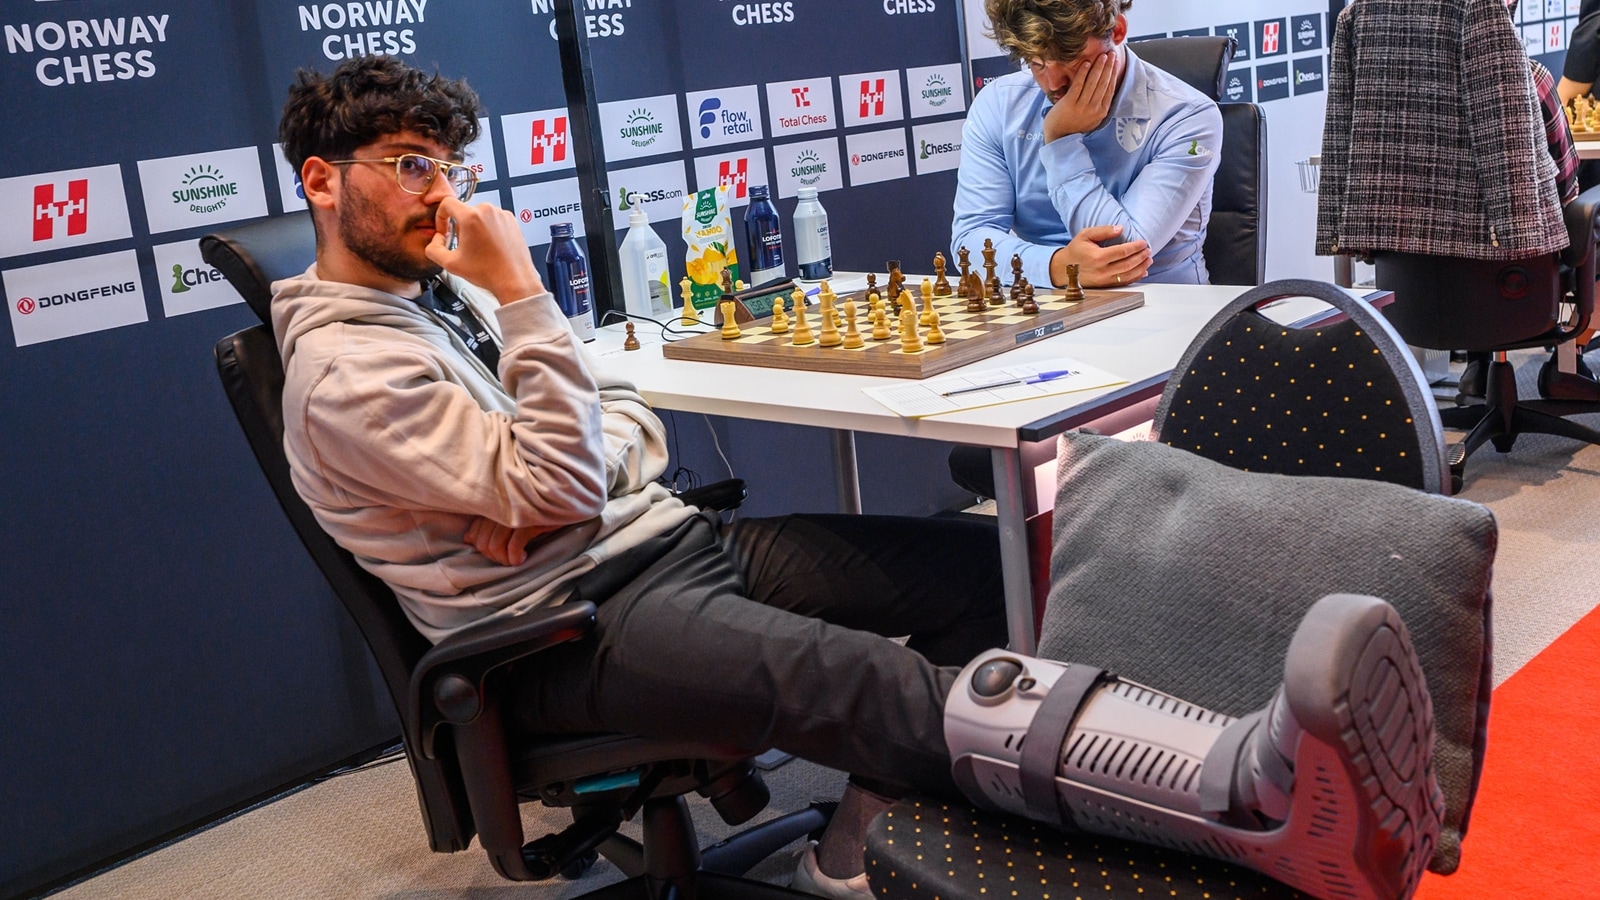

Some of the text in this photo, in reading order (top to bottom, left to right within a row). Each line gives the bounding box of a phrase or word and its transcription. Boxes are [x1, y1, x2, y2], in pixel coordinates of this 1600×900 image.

[732, 1, 795, 25] CHESS
[883, 0, 936, 15] CHESS
[298, 0, 427, 31] NORWAY
[4, 14, 169, 53] NORWAY
[549, 13, 625, 40] ESS
[322, 29, 417, 60] CHESS
[36, 49, 156, 86] CHESS
[921, 86, 952, 99] SUNSHINE
[721, 110, 747, 124] flow
[779, 114, 828, 128] Total Chess
[620, 123, 663, 138] SUNSHINE
[723, 119, 753, 136] retail
[631, 136, 656, 147] DELIGHTS
[1026, 132, 1045, 141] coh
[860, 149, 904, 163] DONGFENG
[791, 163, 826, 177] SUNSHINE
[172, 182, 238, 203] SUNSHINE
[189, 200, 227, 214] DELIGHTS
[534, 203, 581, 218] DONGFE
[183, 268, 227, 286] Che
[39, 282, 136, 308] DONGFENG
